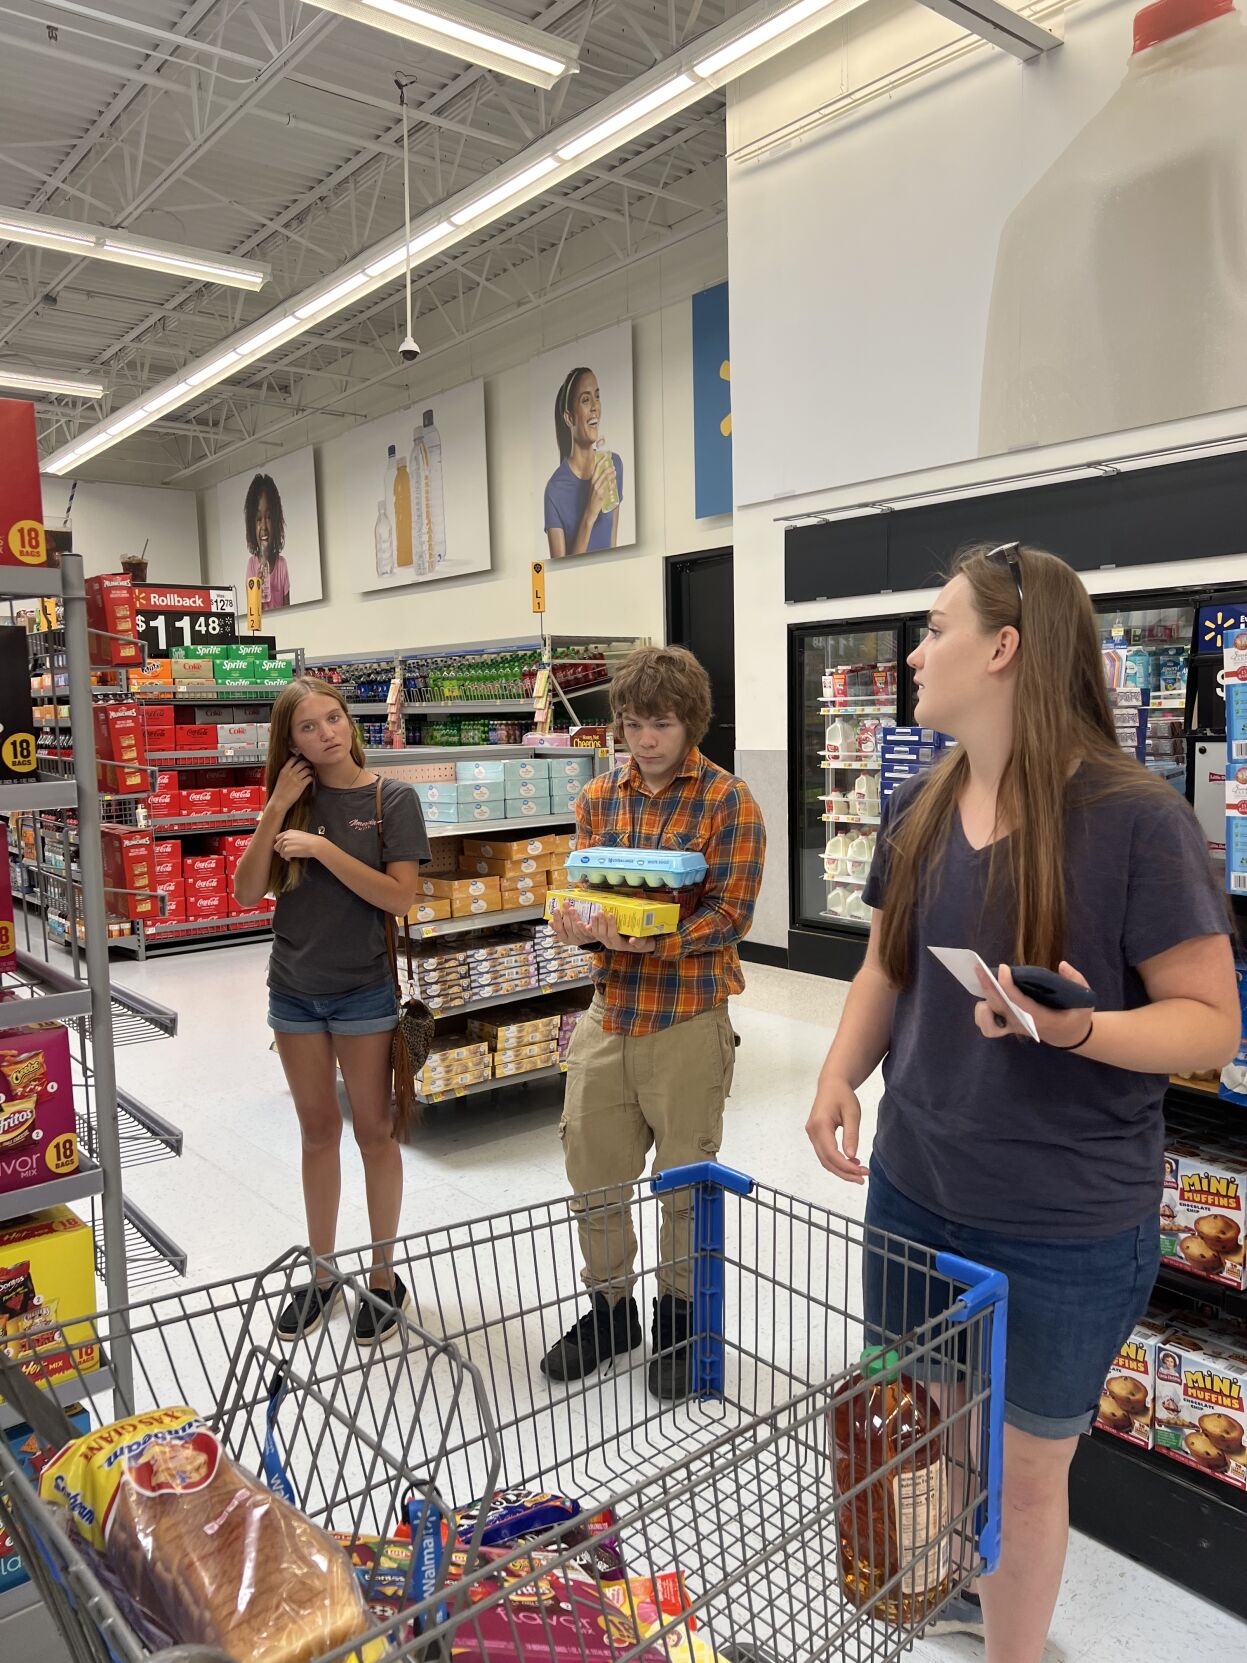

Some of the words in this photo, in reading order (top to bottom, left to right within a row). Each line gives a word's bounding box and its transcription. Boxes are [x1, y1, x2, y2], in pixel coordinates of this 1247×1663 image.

[18, 527, 39, 550] 18
[19, 549, 40, 557] BAGS
[150, 593, 204, 608] Rollback
[196, 645, 221, 656] Sprite
[238, 645, 262, 655] Sprite
[183, 663, 202, 671] Coke
[222, 660, 247, 670] Sprite
[262, 660, 286, 670] Sprite
[229, 727, 246, 735] Coke
[11, 739, 31, 760] 18
[53, 1138, 74, 1162] 18
[0, 1152, 41, 1176] vor
[55, 1159, 75, 1170] BAGS
[21, 1168, 37, 1179] MIX
[1184, 1191, 1237, 1208] MUFFINS
[1179, 1202, 1211, 1212] CHOCOLATE
[49, 1360, 63, 1370] MIX
[1183, 1397, 1215, 1410] CHOCOLATE
[1188, 1388, 1240, 1409] MUFFINS
